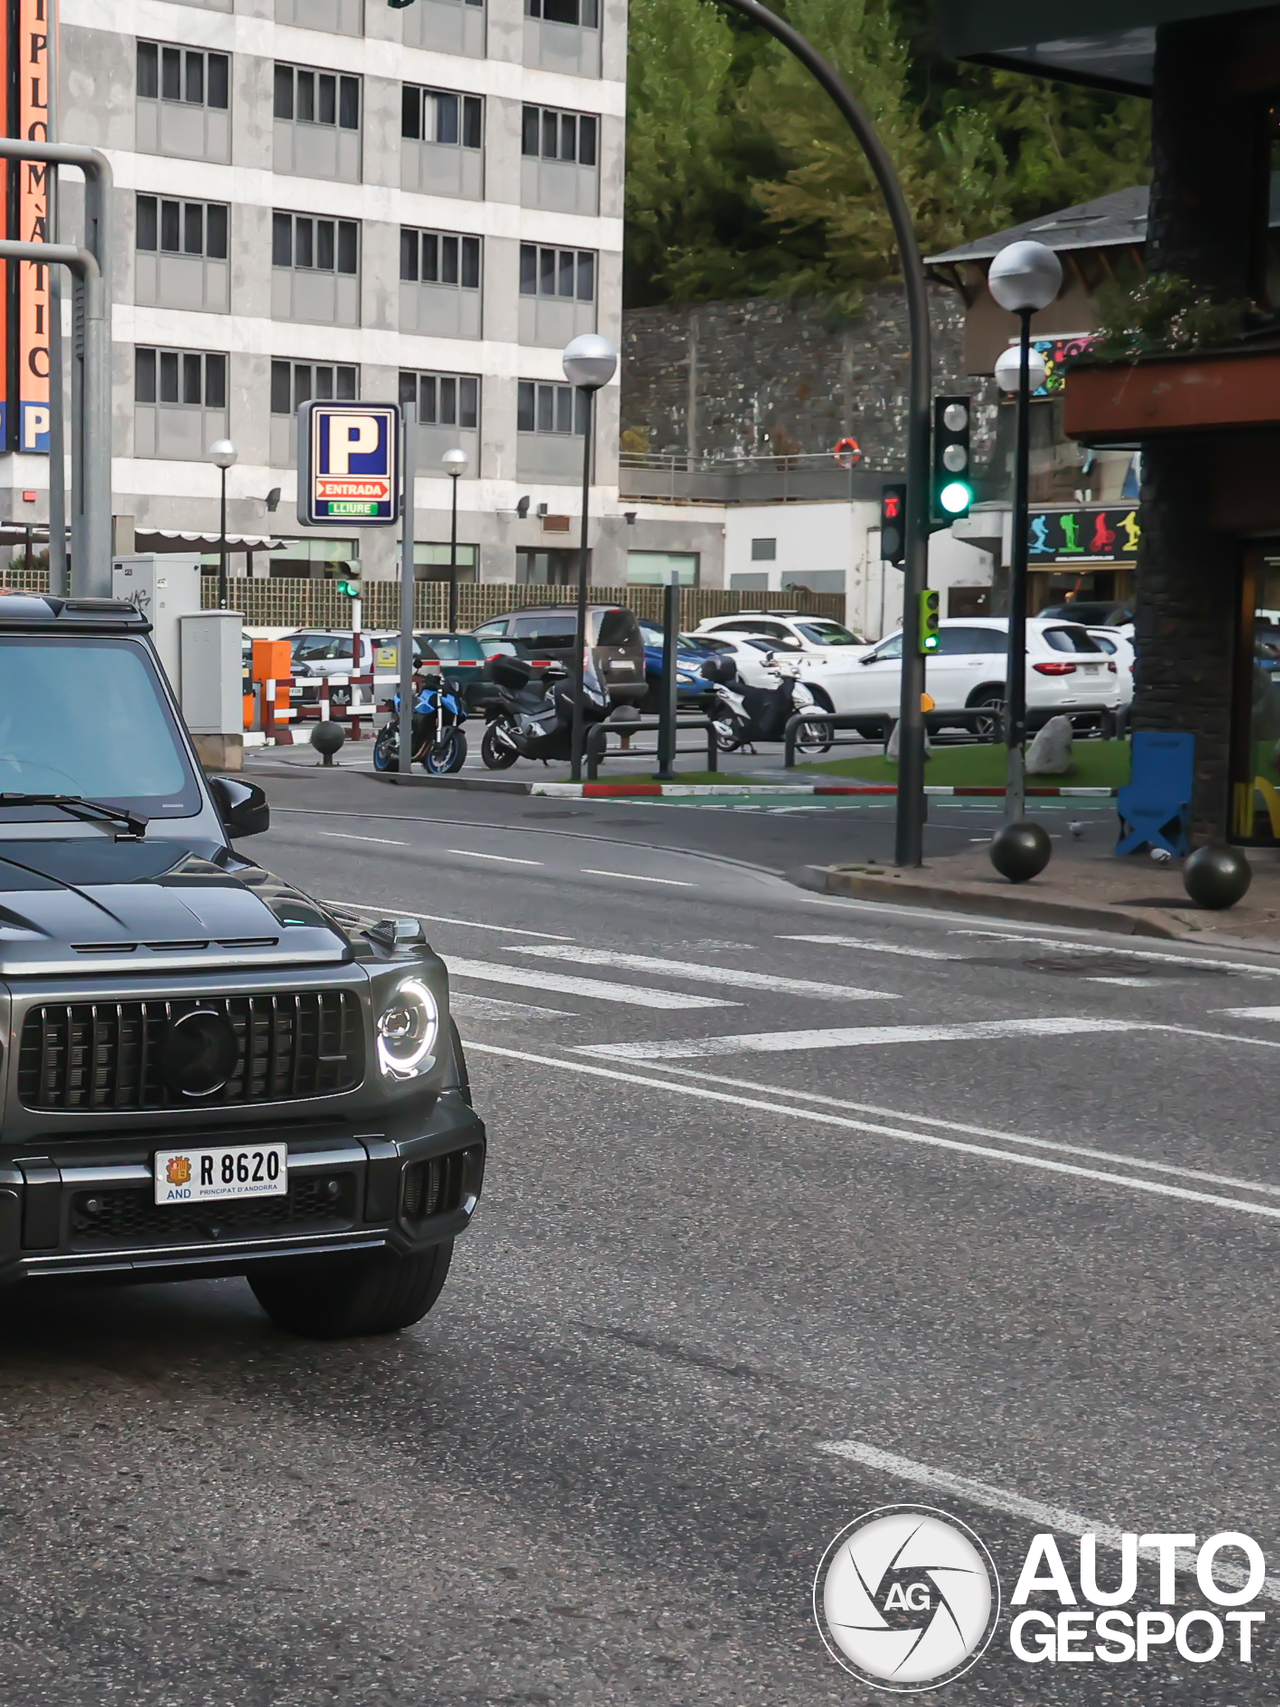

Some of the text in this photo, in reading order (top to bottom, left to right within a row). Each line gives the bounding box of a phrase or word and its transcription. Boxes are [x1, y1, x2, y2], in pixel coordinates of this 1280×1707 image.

[24, 406, 50, 448] P
[329, 415, 379, 474] P
[325, 484, 382, 495] ENTRADA
[333, 503, 372, 513] LLIURE
[201, 1151, 279, 1186] R 8620
[167, 1188, 191, 1200] AND
[199, 1184, 278, 1196] PRINCIPAT D'ANDORRA
